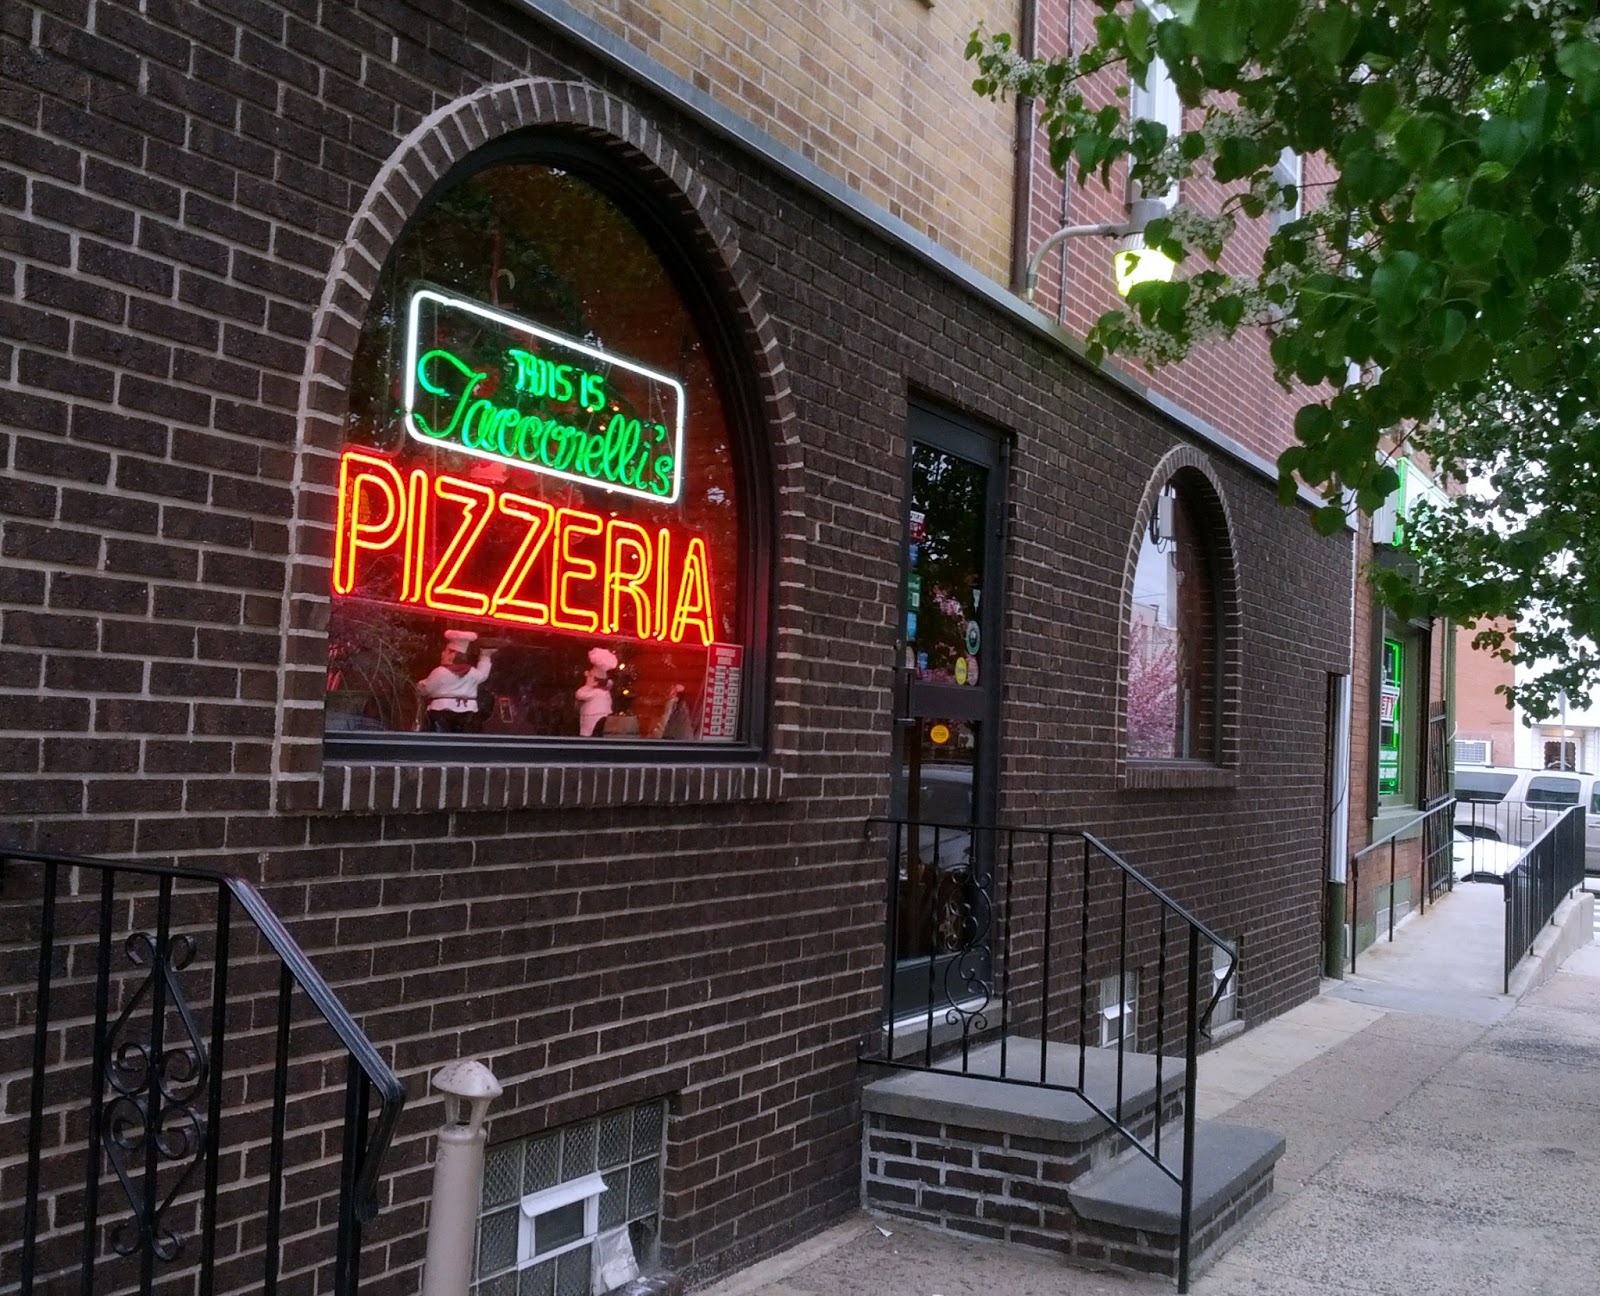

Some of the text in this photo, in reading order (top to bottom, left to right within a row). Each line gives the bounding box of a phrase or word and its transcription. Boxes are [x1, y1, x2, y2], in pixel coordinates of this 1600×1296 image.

[414, 349, 674, 496] Tacconelli's
[508, 349, 605, 411] THIS IS
[333, 452, 714, 646] PIZZERIA
